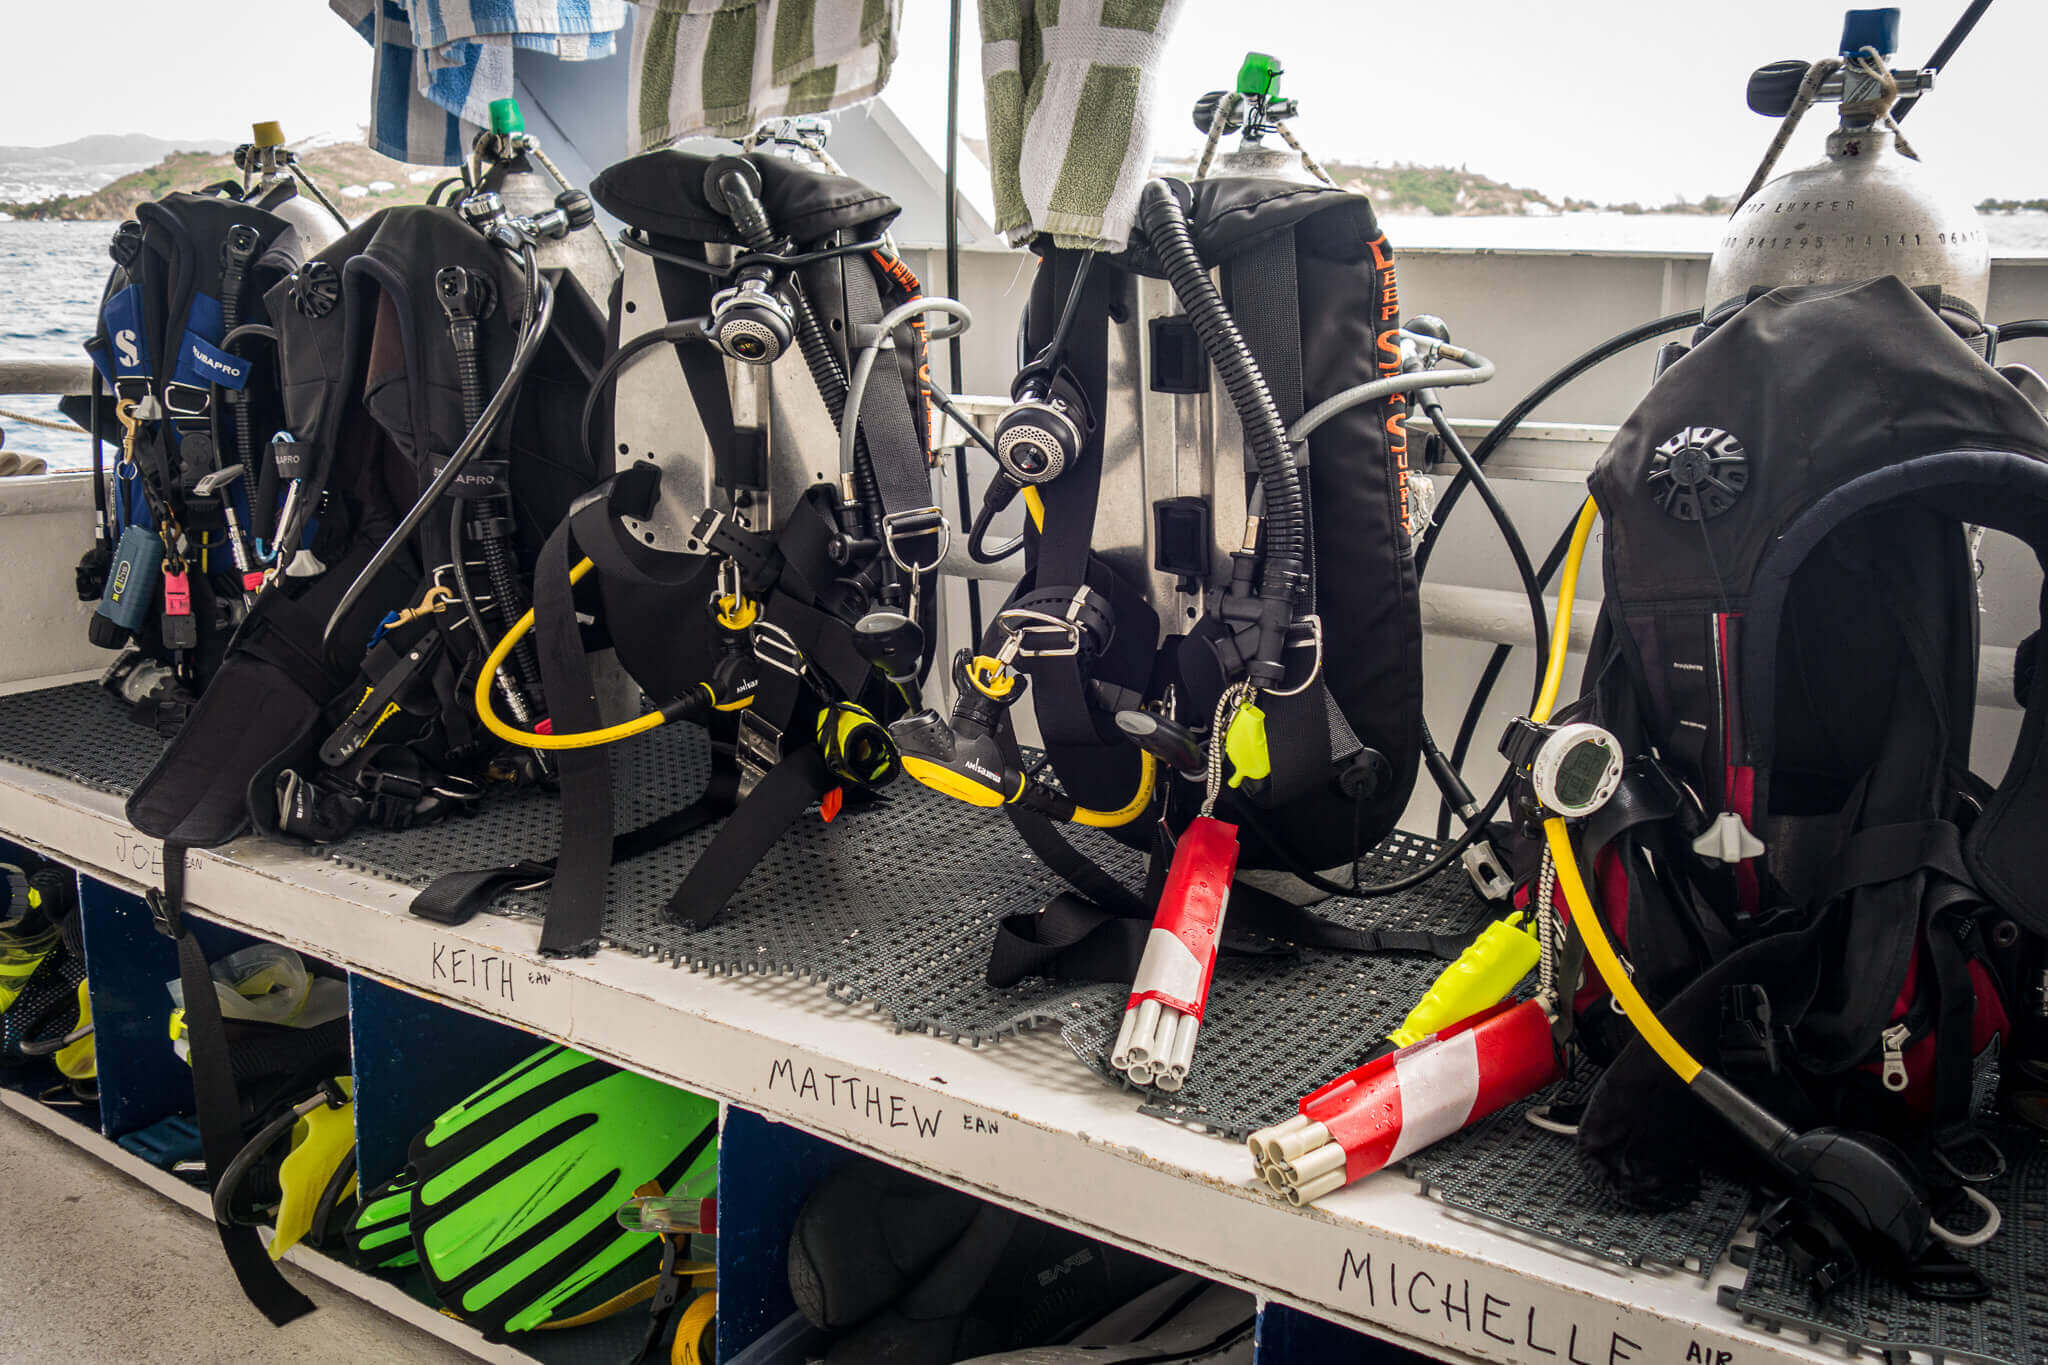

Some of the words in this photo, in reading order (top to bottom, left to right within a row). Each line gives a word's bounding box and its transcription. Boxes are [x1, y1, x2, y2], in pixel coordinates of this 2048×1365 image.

[1376, 328, 1407, 405] SA
[1386, 412, 1412, 536] SUPPLY
[113, 831, 164, 875] JOE
[432, 941, 515, 1002] KEITH
[528, 971, 552, 986] EAN
[769, 1058, 943, 1138] MATTHEW
[963, 1113, 999, 1134] EAN
[1338, 1248, 1642, 1365] MICHELLE
[1686, 1340, 1734, 1365] AIR
